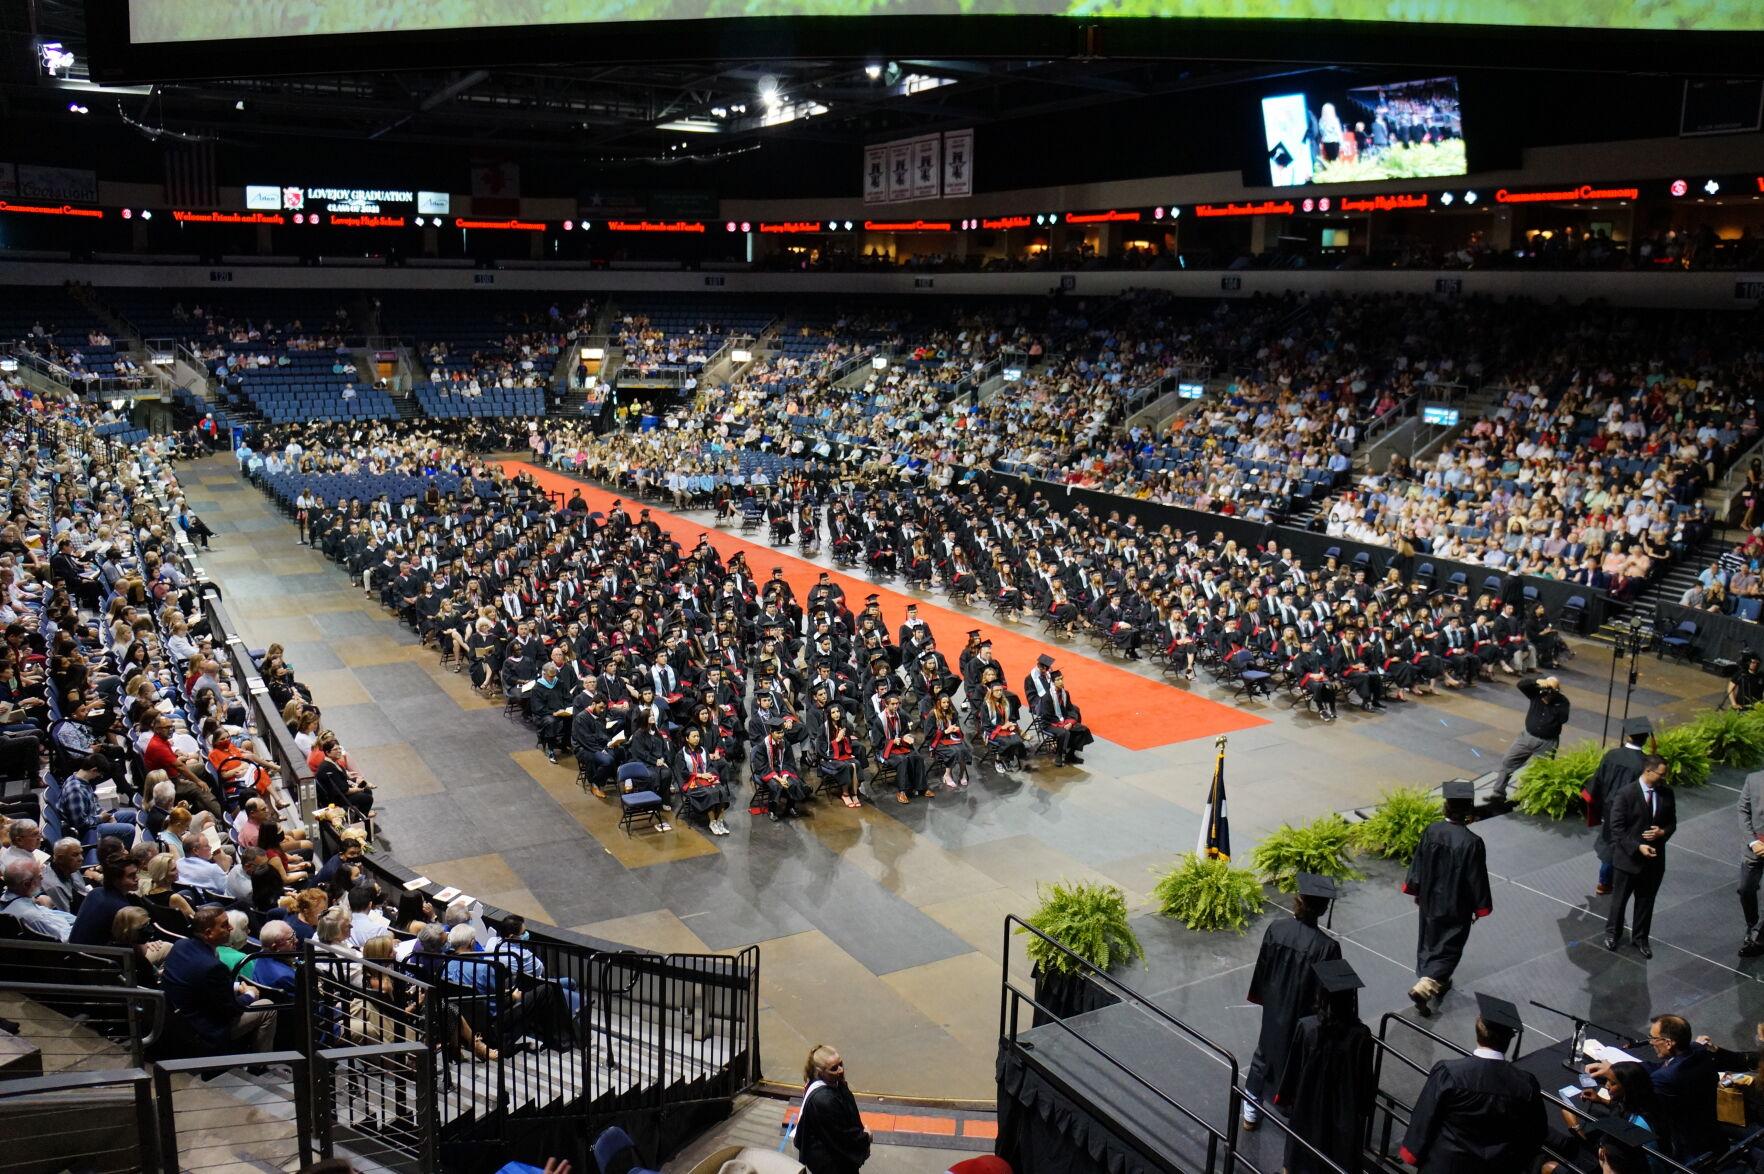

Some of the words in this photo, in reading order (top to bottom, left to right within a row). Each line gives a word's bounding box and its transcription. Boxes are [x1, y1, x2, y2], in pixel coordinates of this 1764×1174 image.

[308, 188, 350, 201] LOVEJOY
[351, 190, 413, 202] GRADUATION
[0, 200, 62, 215] Commencement
[63, 205, 103, 218] Ceremony
[327, 203, 350, 212] CLASS
[350, 204, 360, 212] OF
[173, 211, 212, 222] Welcome
[212, 211, 241, 222] Friends
[241, 213, 256, 223] and
[257, 213, 285, 224] Family
[331, 215, 360, 226] Lovejoy
[360, 215, 379, 227] High
[379, 216, 404, 226] School
[608, 221, 641, 231] Welcome
